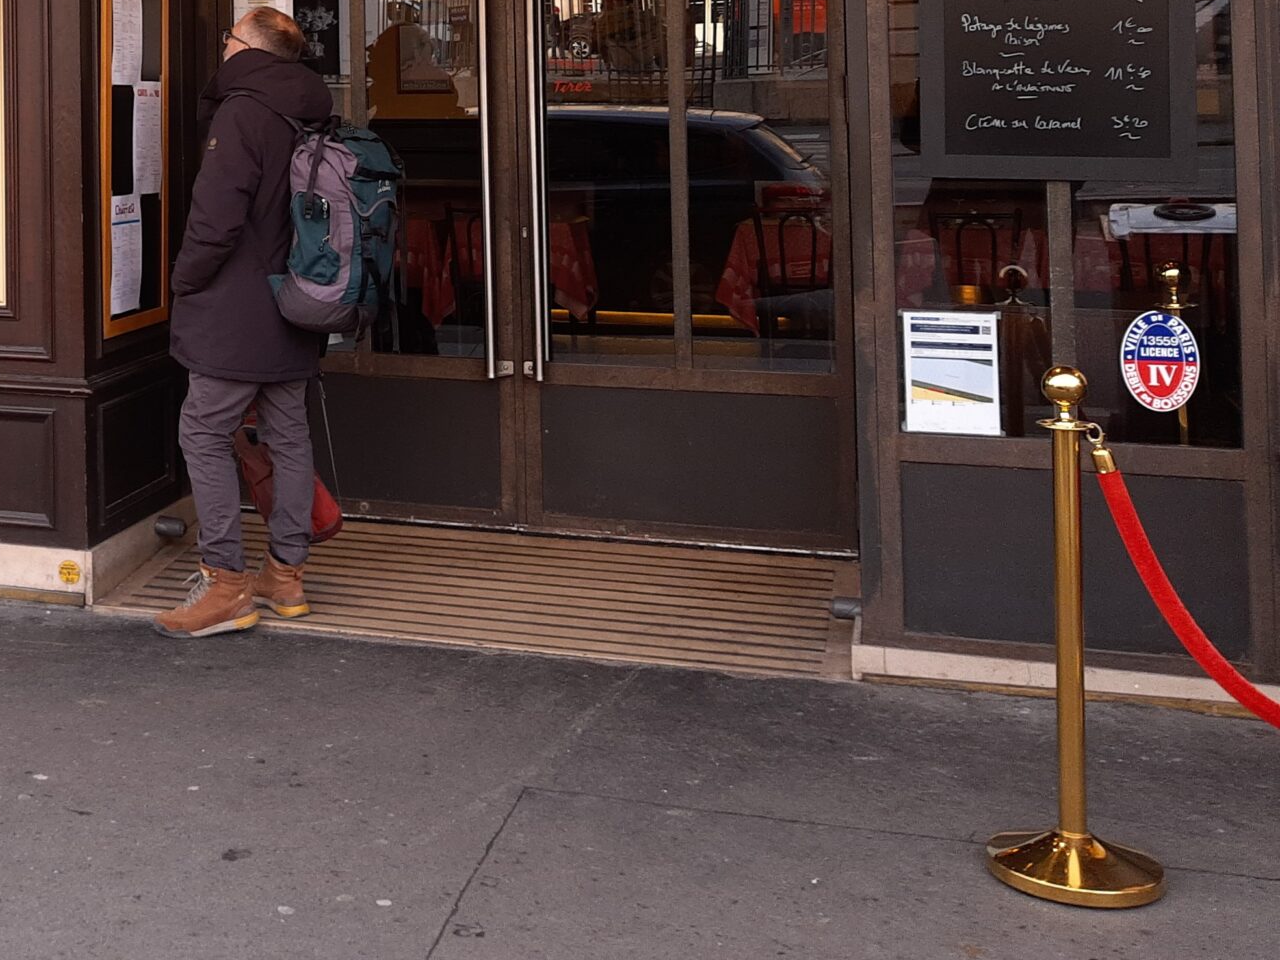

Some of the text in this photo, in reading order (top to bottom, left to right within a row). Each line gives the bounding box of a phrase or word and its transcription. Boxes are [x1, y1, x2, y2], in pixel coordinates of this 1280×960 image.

[1124, 314, 1196, 355] VILLE DE PARIS
[1141, 335, 1179, 347] 13559
[1140, 346, 1180, 358] LICENCE
[1147, 364, 1179, 387] IV
[1151, 365, 1197, 410] BOISSONS
